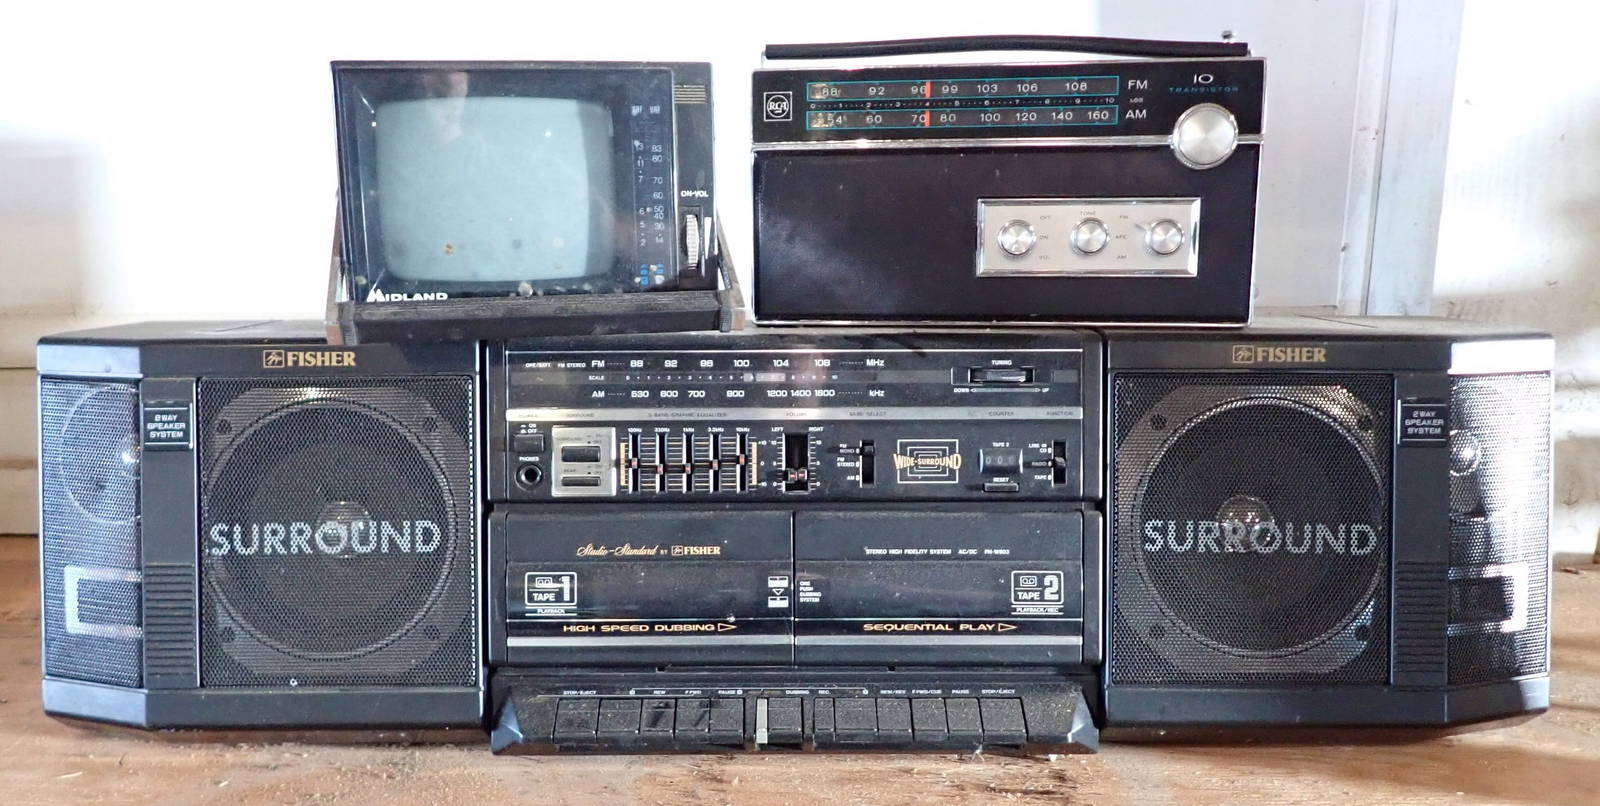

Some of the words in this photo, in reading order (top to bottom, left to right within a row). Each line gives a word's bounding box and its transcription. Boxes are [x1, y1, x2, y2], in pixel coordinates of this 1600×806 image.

[822, 87, 839, 96] 88
[869, 86, 886, 96] 92
[942, 84, 959, 94] 99
[977, 84, 998, 93] 103
[1016, 83, 1038, 93] 106
[1065, 82, 1087, 92] 108
[1127, 79, 1148, 90] FM
[1168, 86, 1239, 94] TRANSISTOR
[769, 101, 789, 114] RCA
[866, 115, 882, 124] 60
[912, 114, 927, 123] 70
[940, 113, 957, 122] 80
[979, 112, 1001, 121] 100
[1015, 112, 1037, 121] 120
[1051, 111, 1073, 120] 140
[1087, 110, 1109, 119] 160
[1125, 109, 1147, 119] AM
[653, 176, 664, 185] 70
[653, 191, 664, 200] 60
[680, 190, 710, 198] ON-VOL
[639, 207, 645, 215] 6
[653, 205, 664, 213] 50
[653, 212, 664, 220] 40
[366, 288, 449, 303] MIDLAND
[286, 351, 357, 367] FISHER
[1256, 347, 1327, 363] FISHER
[591, 359, 605, 368] FM
[664, 359, 678, 368] 92
[733, 359, 750, 367] 100
[773, 359, 789, 367] 104
[814, 358, 831, 367] 108
[866, 358, 885, 367] MHz
[591, 390, 605, 398] AM
[631, 390, 649, 398] 530
[687, 390, 706, 398] 700
[766, 389, 788, 397] 1200
[790, 389, 812, 397] 1400
[869, 389, 885, 397] kHz
[147, 422, 186, 430] SPEAKER
[1404, 418, 1444, 426] SPEAKER
[210, 520, 442, 555] SURROUND
[1144, 520, 1377, 555] SURROUND
[683, 546, 721, 555] FISHER
[532, 592, 556, 602] TAPE
[558, 575, 570, 602] 1
[1017, 591, 1041, 601] TAPE
[1043, 574, 1059, 601] 2
[562, 624, 596, 632] HIGH
[601, 624, 649, 632] SPEED
[654, 623, 715, 632] DUBBING
[863, 623, 954, 632] SEQUENTIAL
[959, 623, 996, 632] PLAY
